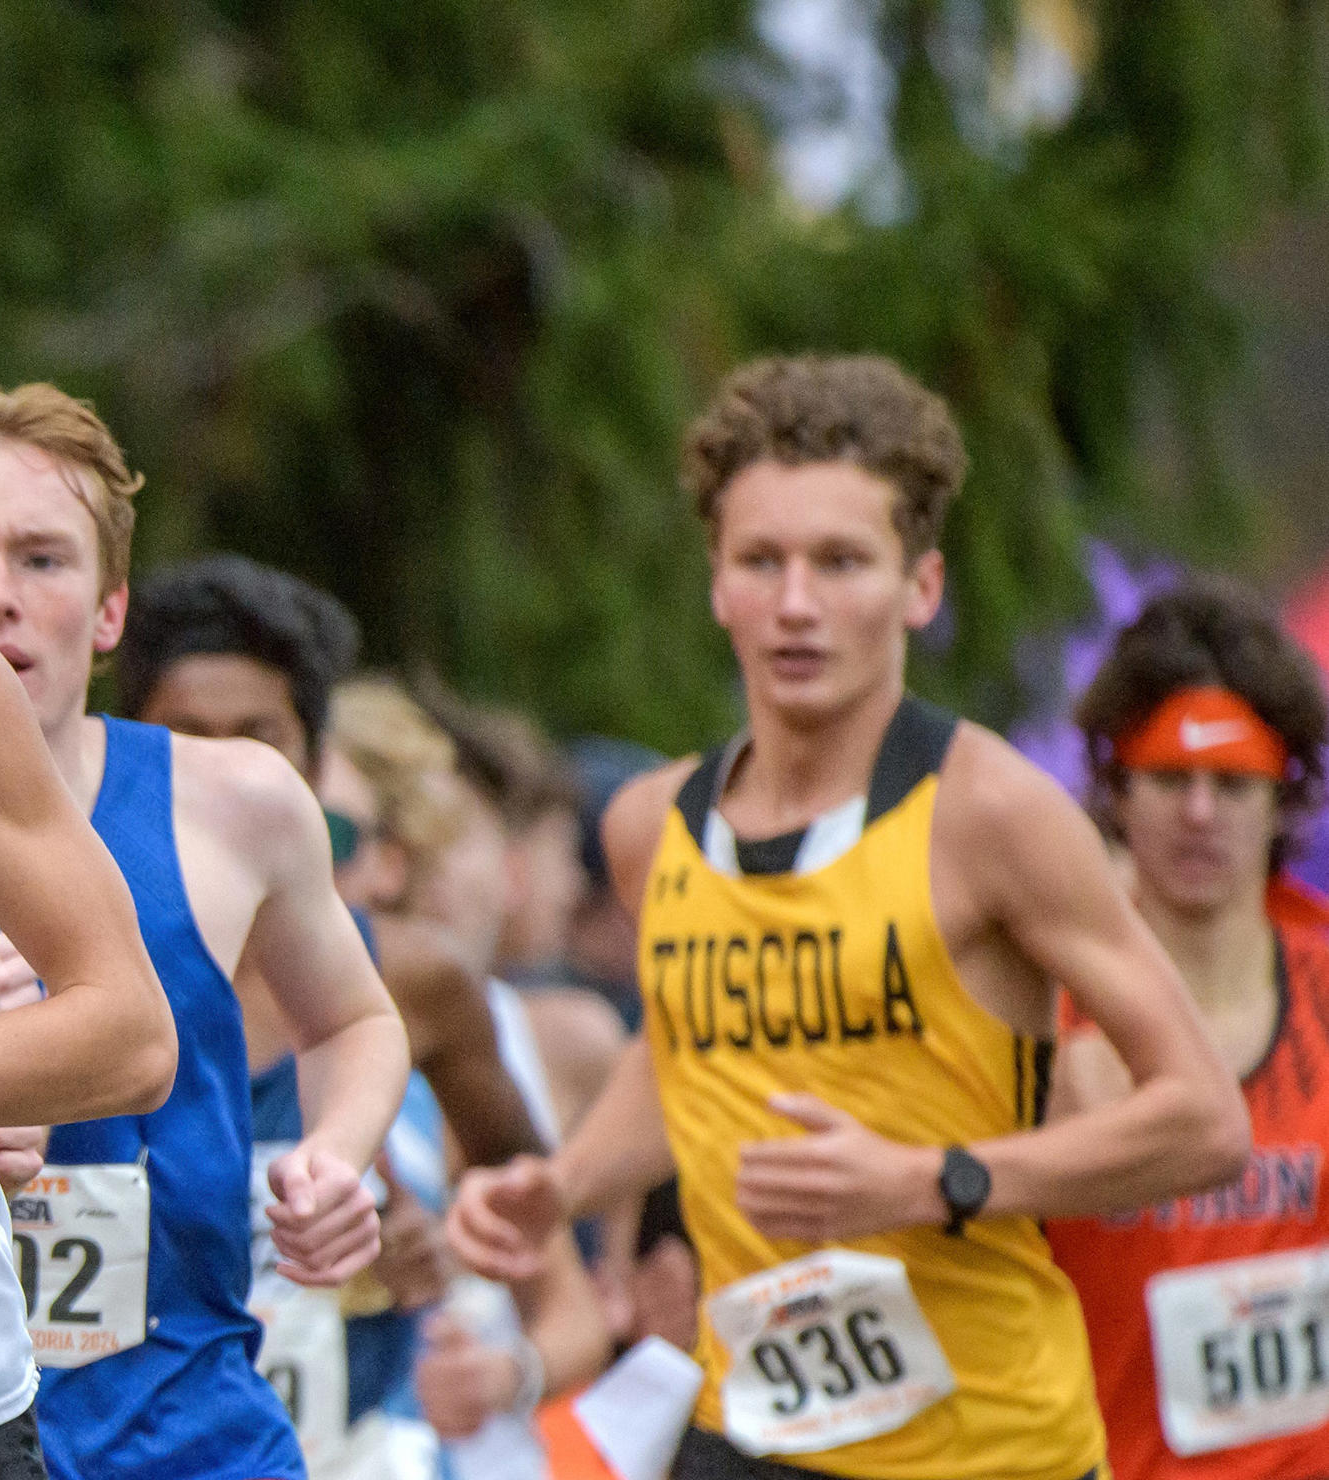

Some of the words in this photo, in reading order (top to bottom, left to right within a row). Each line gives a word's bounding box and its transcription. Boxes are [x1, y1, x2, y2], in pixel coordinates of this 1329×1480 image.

[653, 921, 925, 1055] TUSCOLA
[79, 1331, 120, 1351] 2024
[751, 1307, 907, 1417] 936
[1201, 1319, 1329, 1414] 501
